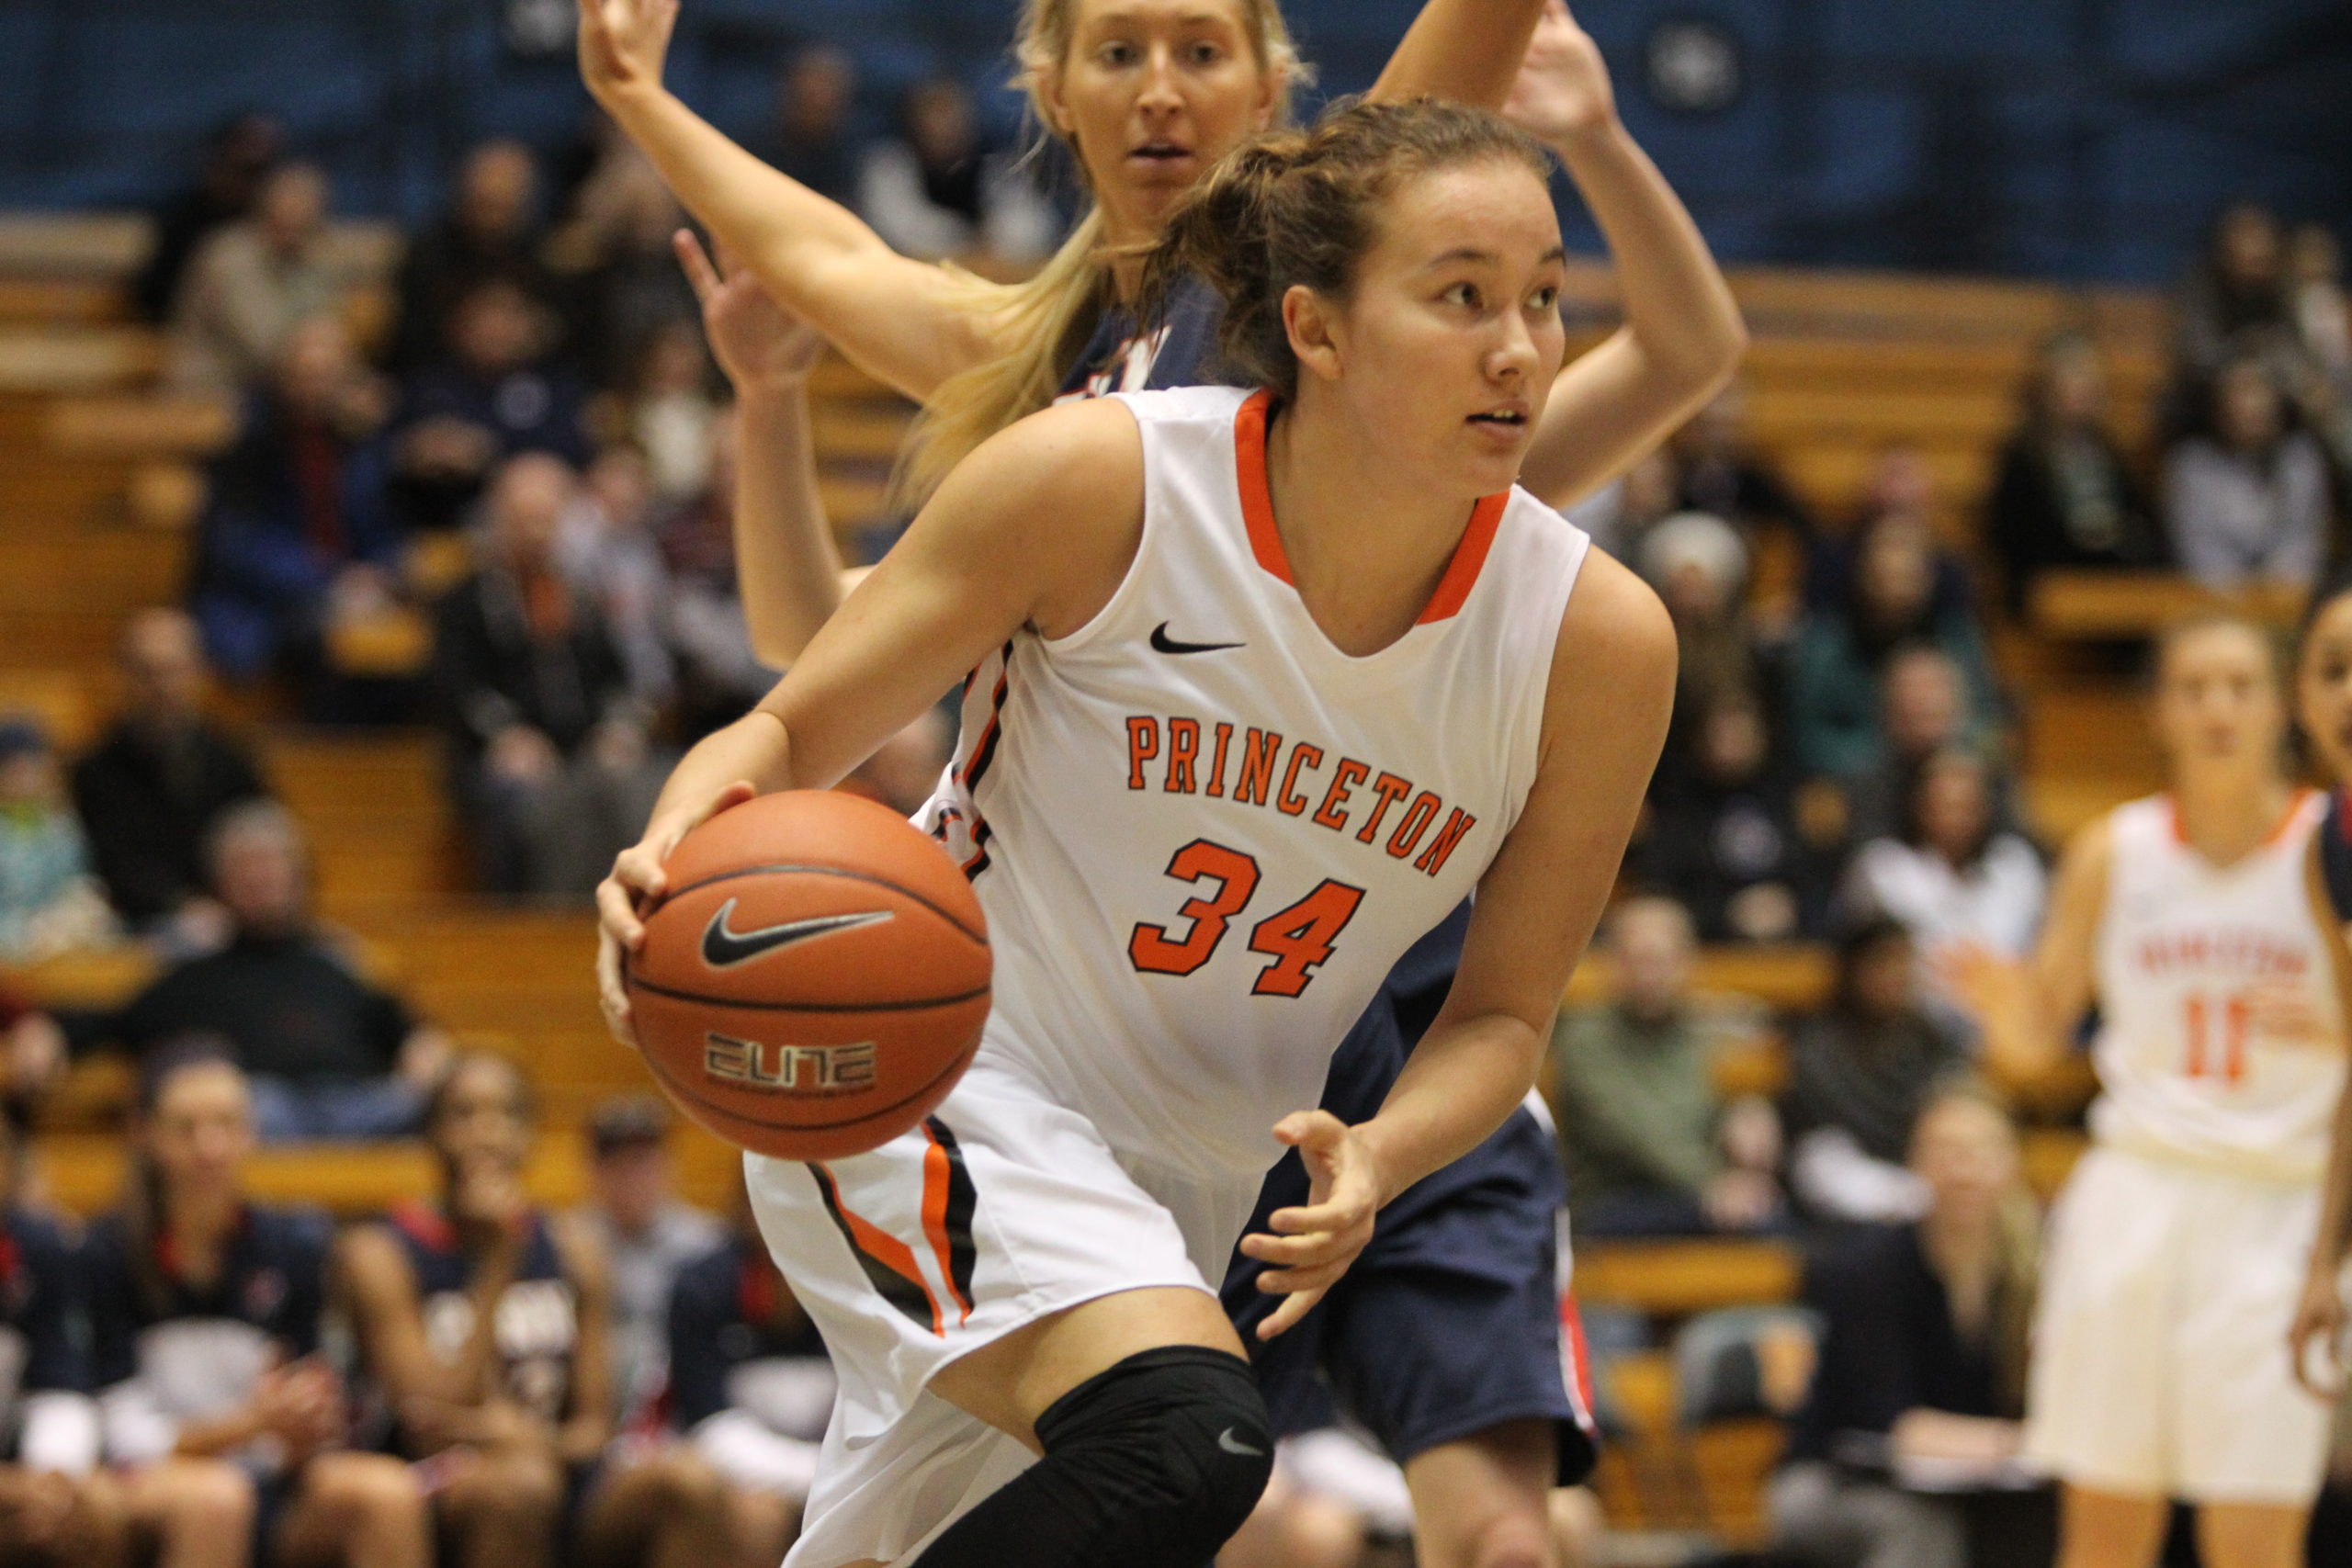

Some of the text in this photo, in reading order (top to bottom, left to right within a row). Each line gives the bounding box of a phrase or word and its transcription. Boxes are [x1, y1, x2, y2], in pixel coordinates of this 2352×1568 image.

[1125, 716, 1477, 877] PRINCETON
[1127, 838, 1367, 999] 34
[704, 1032, 876, 1088] ELITE
